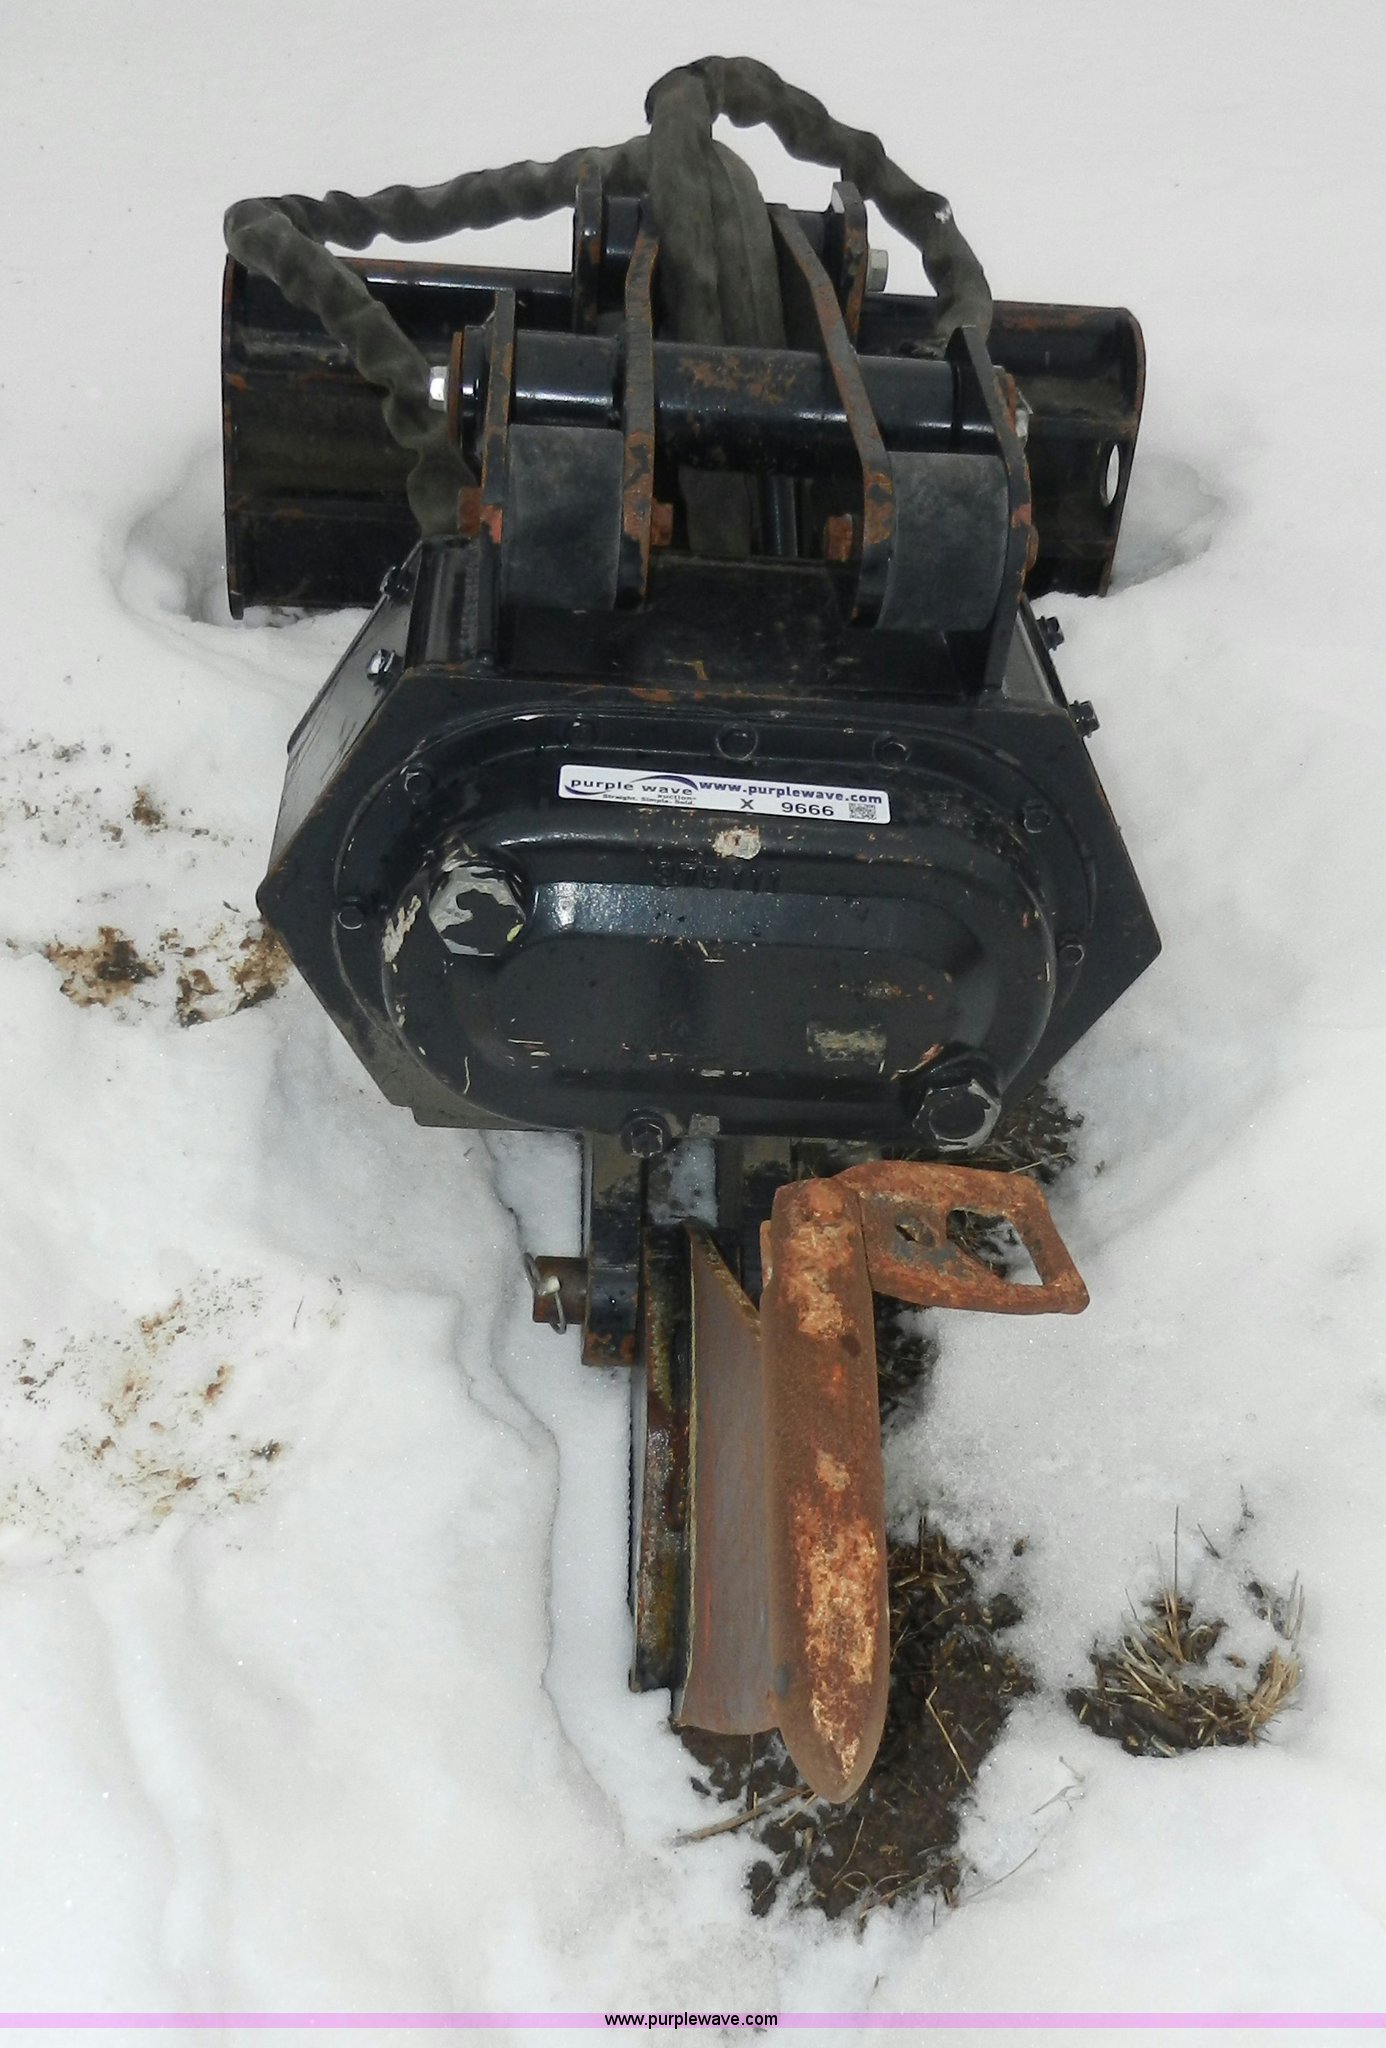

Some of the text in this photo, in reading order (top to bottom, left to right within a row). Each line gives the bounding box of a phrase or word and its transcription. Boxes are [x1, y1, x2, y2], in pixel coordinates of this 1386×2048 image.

[571, 779, 693, 796] purple wave
[699, 781, 882, 803] www.purplewave.com
[740, 798, 755, 810] X
[781, 801, 834, 817] 9666
